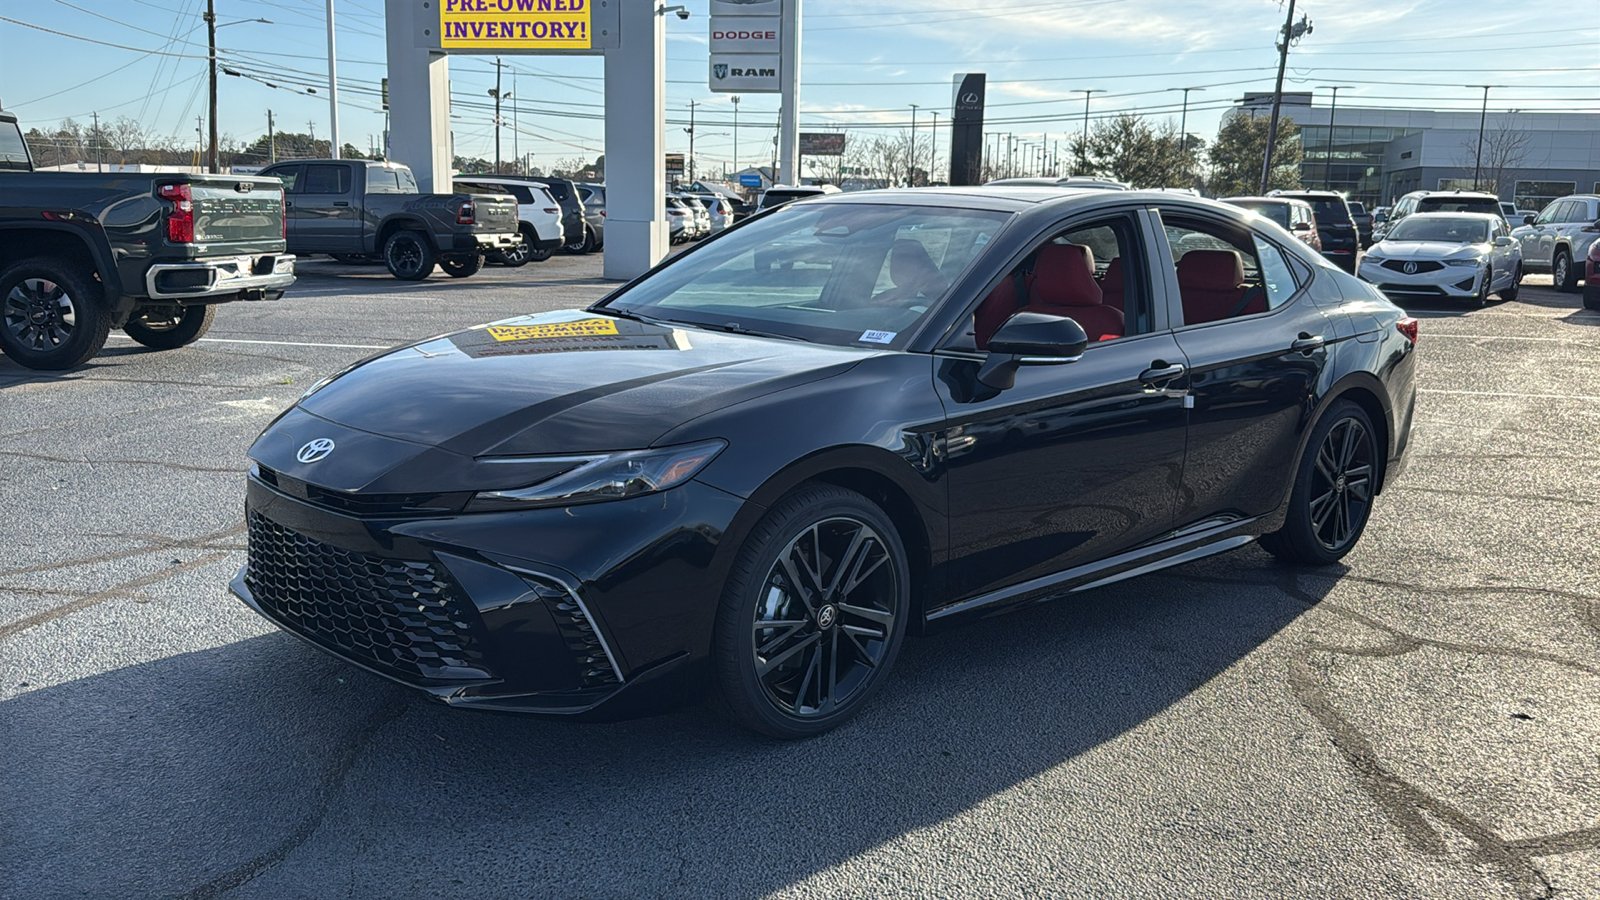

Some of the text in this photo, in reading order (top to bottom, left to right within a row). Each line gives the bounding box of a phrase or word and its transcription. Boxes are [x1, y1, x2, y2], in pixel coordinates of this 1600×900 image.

[446, 0, 584, 12] PRE-OWNED
[444, 21, 586, 39] INVENTORY!
[713, 31, 776, 40] DODGE
[731, 68, 775, 77] RAM
